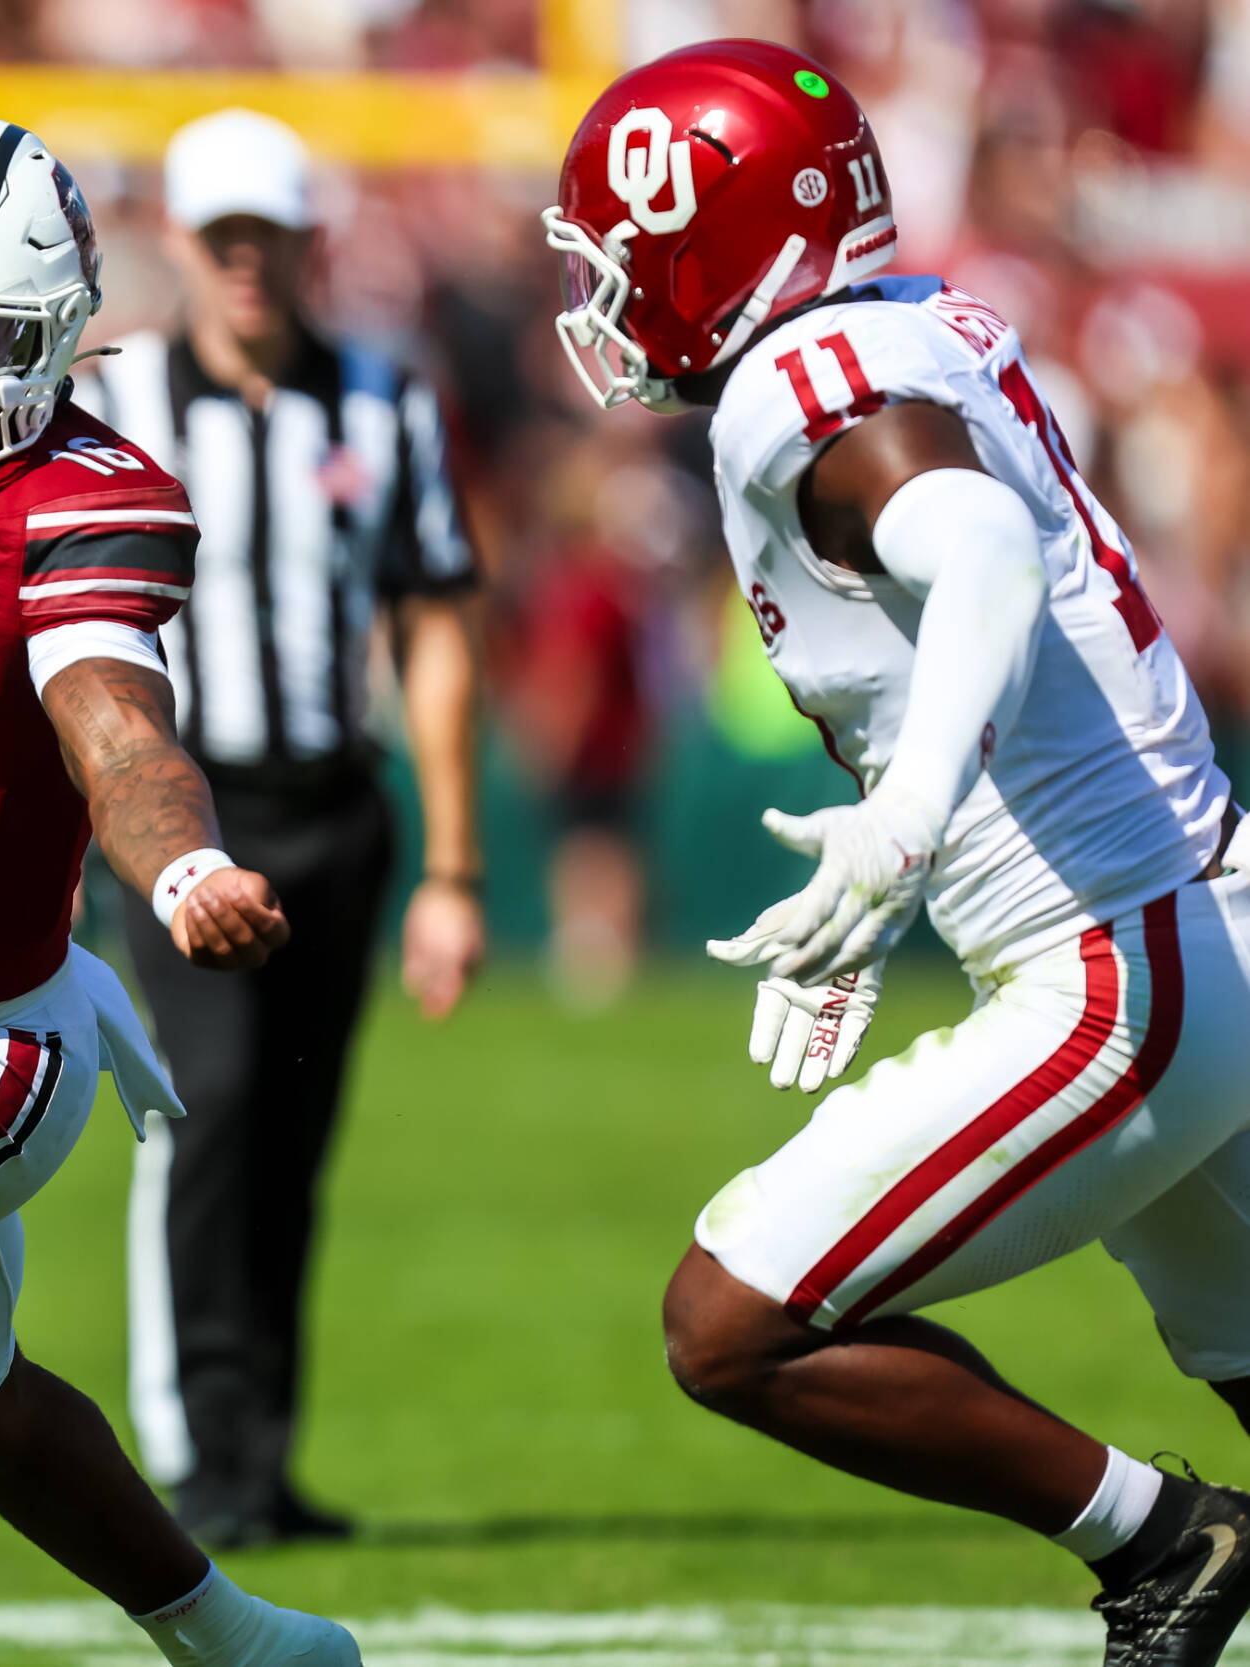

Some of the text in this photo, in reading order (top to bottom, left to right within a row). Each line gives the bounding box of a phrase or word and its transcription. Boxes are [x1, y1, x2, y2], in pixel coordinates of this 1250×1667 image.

[797, 173, 823, 202] SEC
[847, 153, 883, 213] 11
[775, 330, 888, 442] 11
[49, 436, 147, 477] 16
